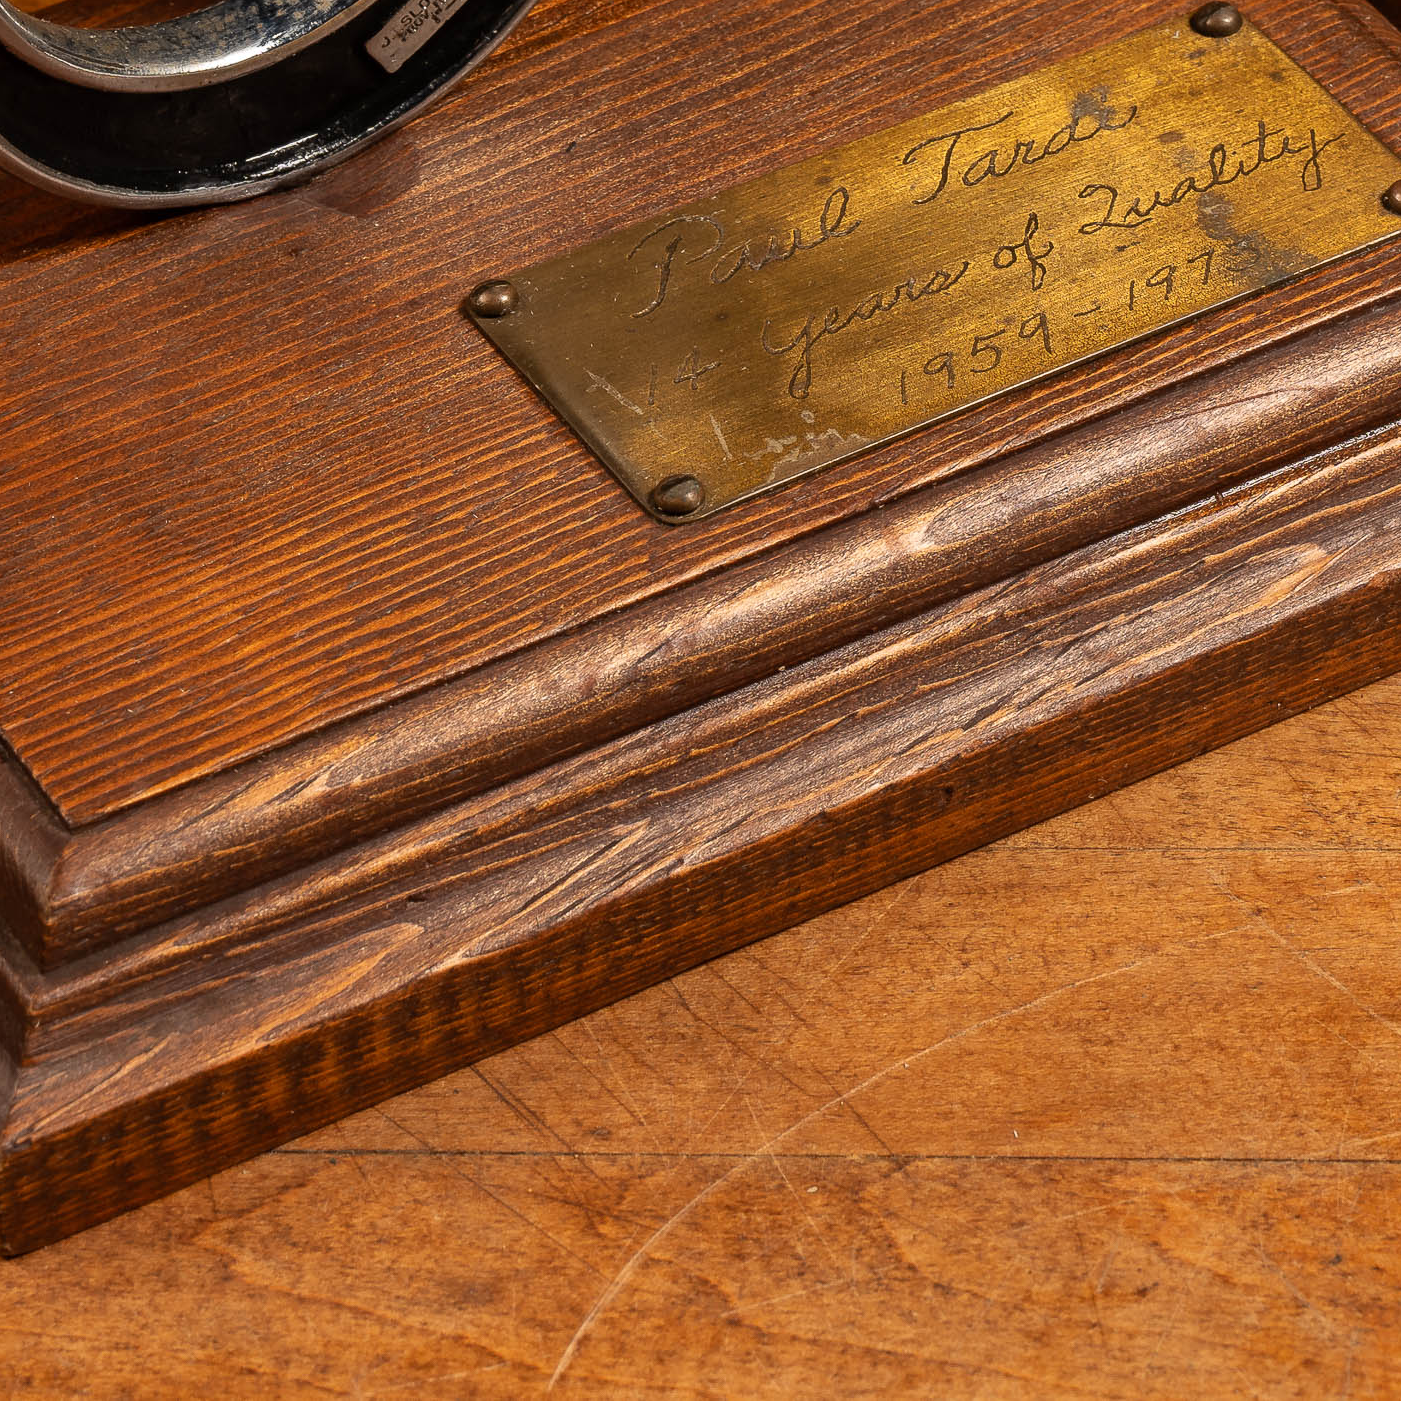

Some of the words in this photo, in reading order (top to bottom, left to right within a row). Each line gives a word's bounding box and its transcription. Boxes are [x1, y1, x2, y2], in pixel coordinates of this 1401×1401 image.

[626, 186, 862, 319] Paul
[648, 345, 721, 405] 14
[993, 211, 1055, 291] of
[1077, 119, 1347, 236] Quality
